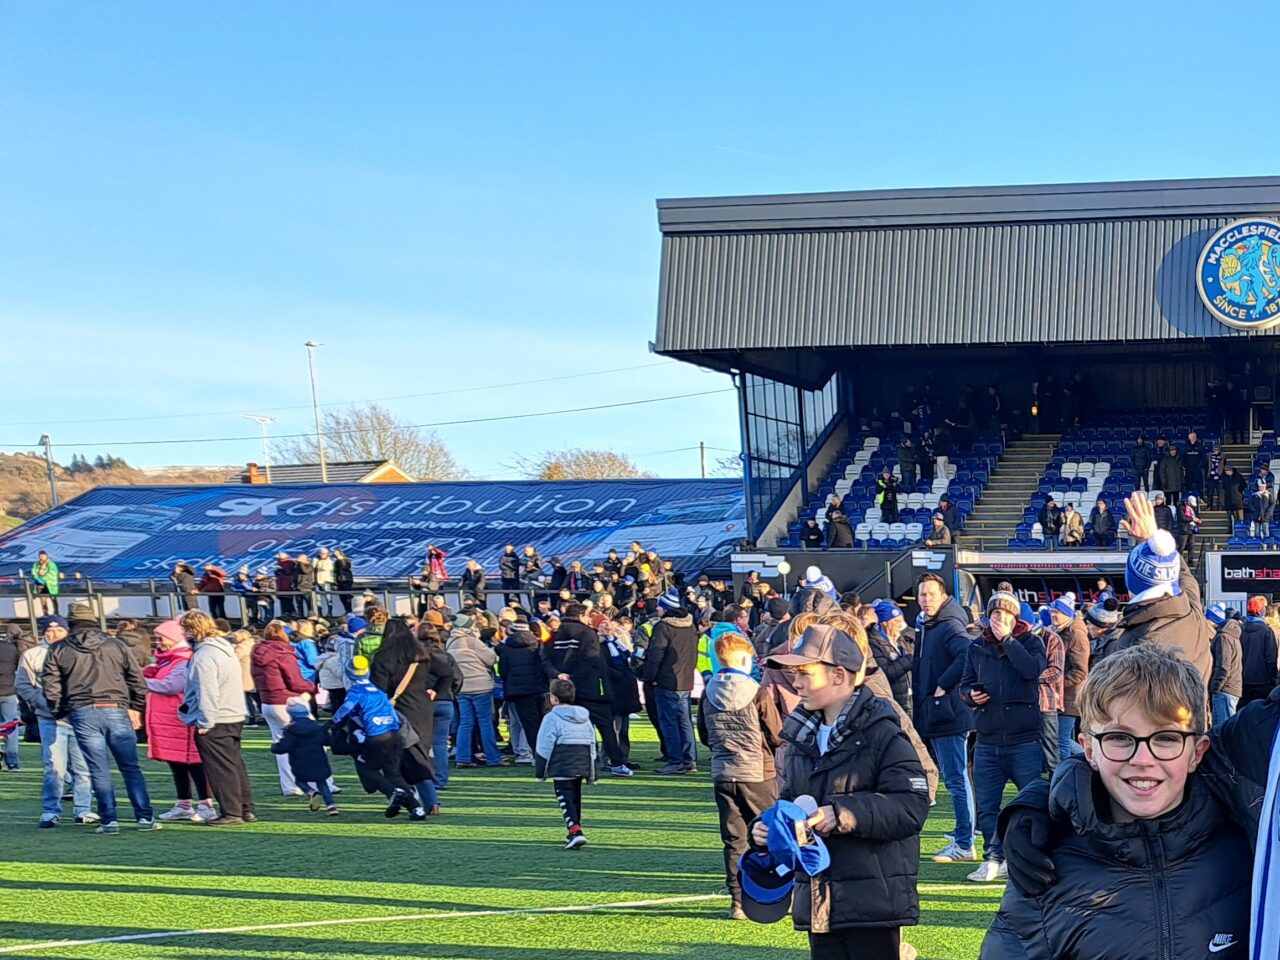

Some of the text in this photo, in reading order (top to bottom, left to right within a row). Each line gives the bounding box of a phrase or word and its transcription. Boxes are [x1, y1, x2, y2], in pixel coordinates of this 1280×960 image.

[1213, 295, 1247, 319] SINCE
[167, 518, 620, 532] Nationwide Pallet Delivery Specialists
[247, 537, 476, 553] 01298 79479
[1134, 558, 1154, 577] THE
[1213, 933, 1233, 945] NIKE
